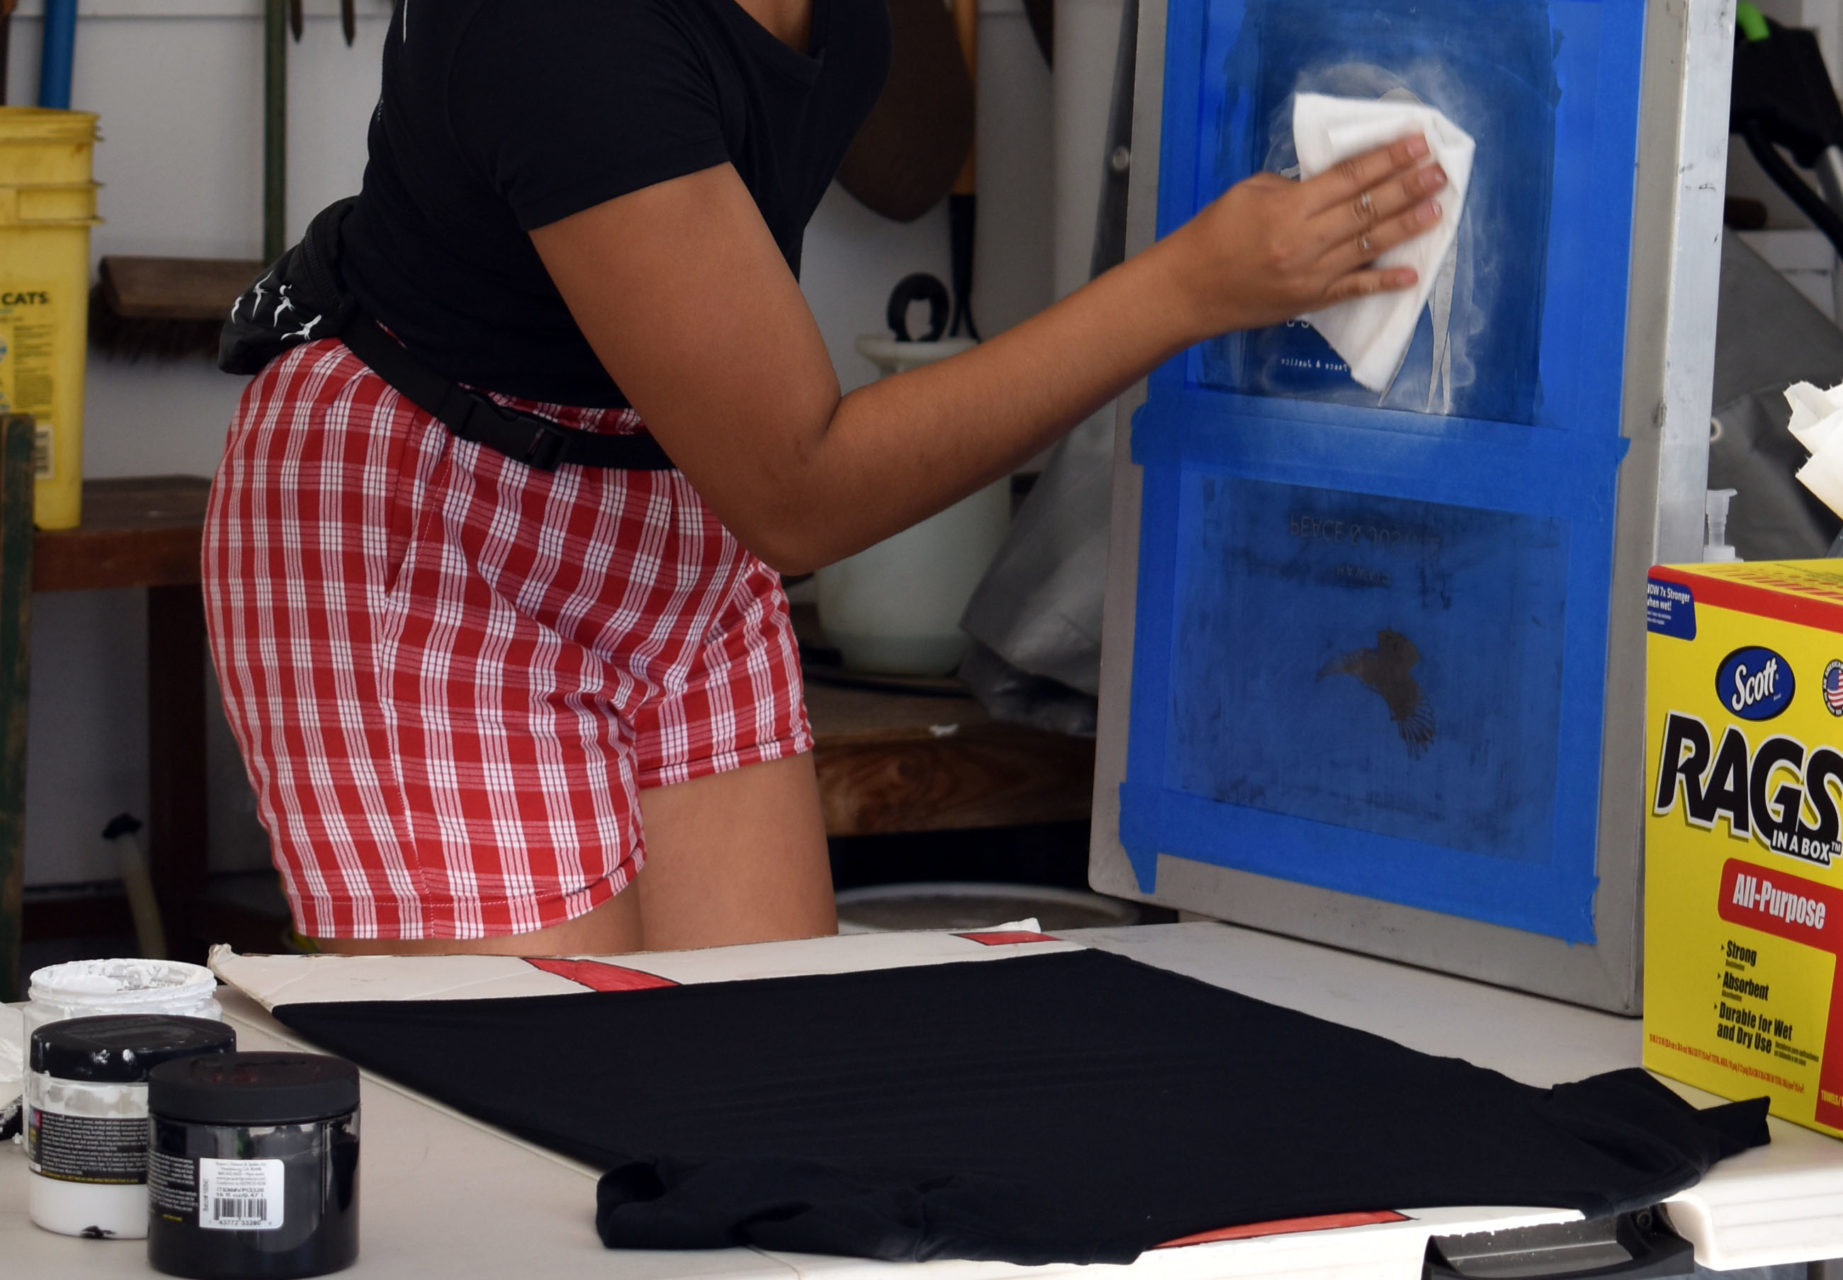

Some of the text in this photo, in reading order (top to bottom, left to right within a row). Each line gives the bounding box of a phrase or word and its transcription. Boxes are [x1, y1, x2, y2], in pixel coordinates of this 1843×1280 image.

[2, 291, 49, 306] CATS
[1667, 587, 1691, 604] Stronger
[1731, 657, 1777, 711] Scott
[1654, 711, 1843, 843] RAGS
[1772, 829, 1788, 850] IN
[1789, 835, 1798, 853] A
[1732, 873, 1826, 930] All-Purpose
[1726, 940, 1757, 967] Strong
[1722, 971, 1769, 1001] Absorbent
[1719, 1001, 1793, 1041] Durable for Wet
[1717, 1023, 1735, 1042] and
[1736, 1026, 1753, 1049] Dry
[1754, 1032, 1772, 1054] Use
